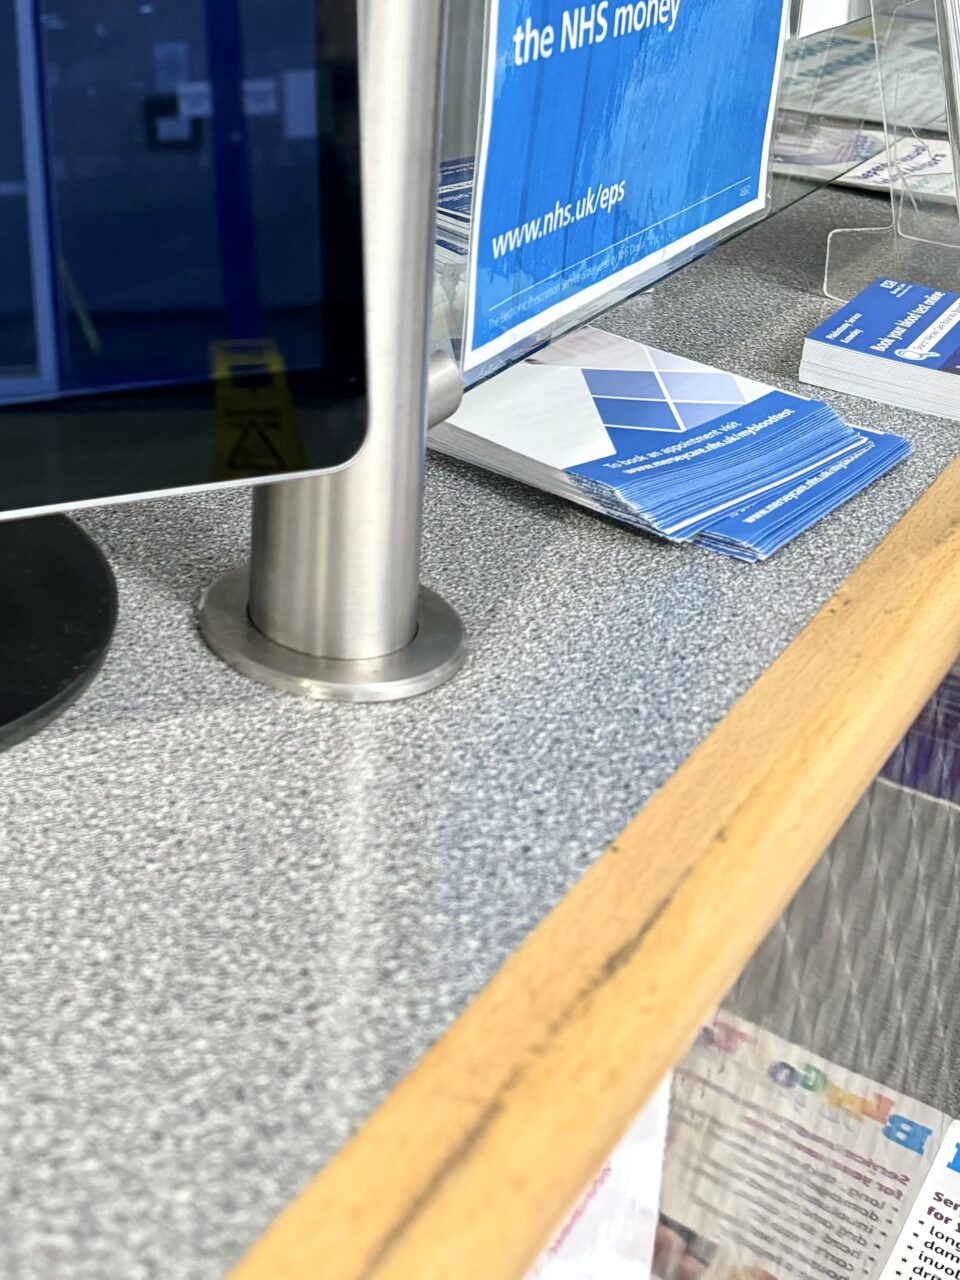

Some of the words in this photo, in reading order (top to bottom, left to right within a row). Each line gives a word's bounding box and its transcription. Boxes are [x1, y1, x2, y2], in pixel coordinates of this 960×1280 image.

[513, 18, 554, 67] the
[560, 1, 608, 53] NHS
[491, 180, 626, 260] www.nhs.uk/eps
[869, 337, 896, 352] Book
[926, 1206, 952, 1225] for
